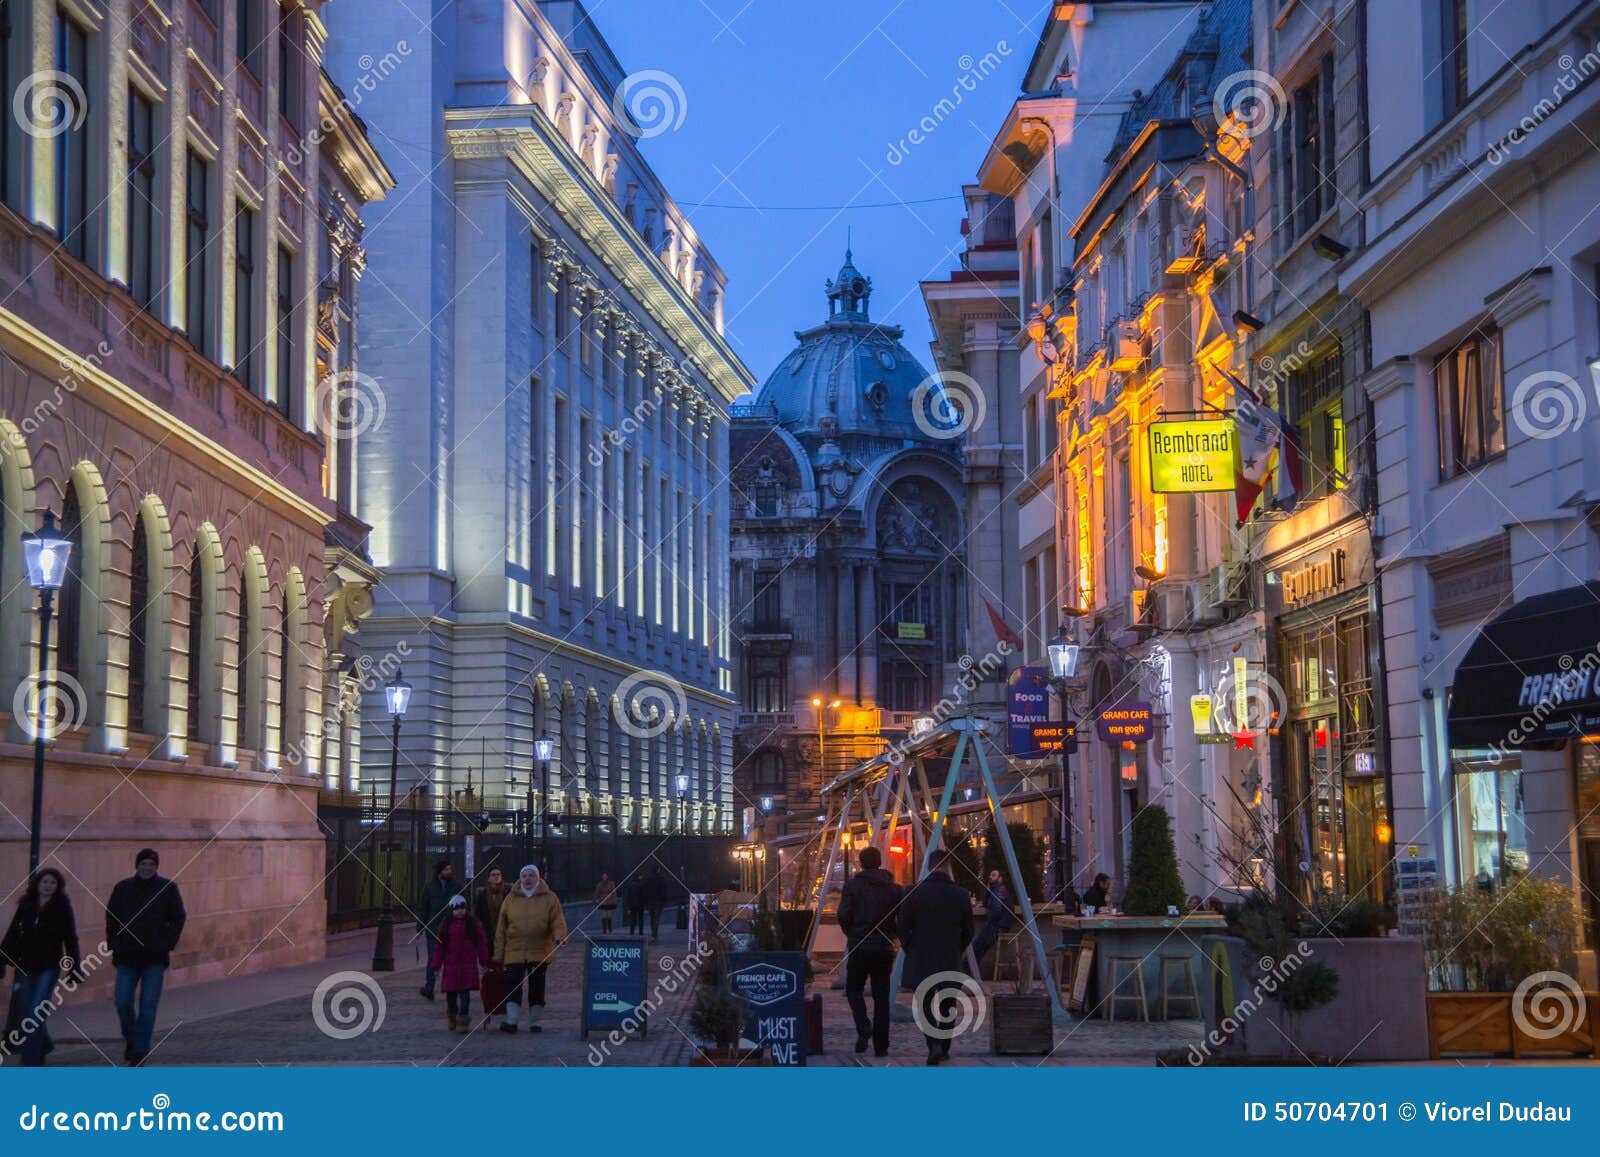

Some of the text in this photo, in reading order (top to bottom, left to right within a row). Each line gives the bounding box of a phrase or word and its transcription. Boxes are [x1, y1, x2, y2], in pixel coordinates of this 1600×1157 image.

[1181, 464, 1213, 482] HOTEL
[1518, 667, 1591, 706] FRENCH
[1015, 693, 1043, 701] FOOD
[1010, 714, 1047, 722] TRAVEL
[1102, 710, 1128, 719] GRAND
[1125, 724, 1145, 734] gogh
[592, 947, 640, 959] SOUVENIR
[602, 961, 630, 972] SHOP
[736, 974, 765, 982] FRENCH
[594, 992, 617, 1001] OPEN
[759, 1017, 797, 1040] MUST
